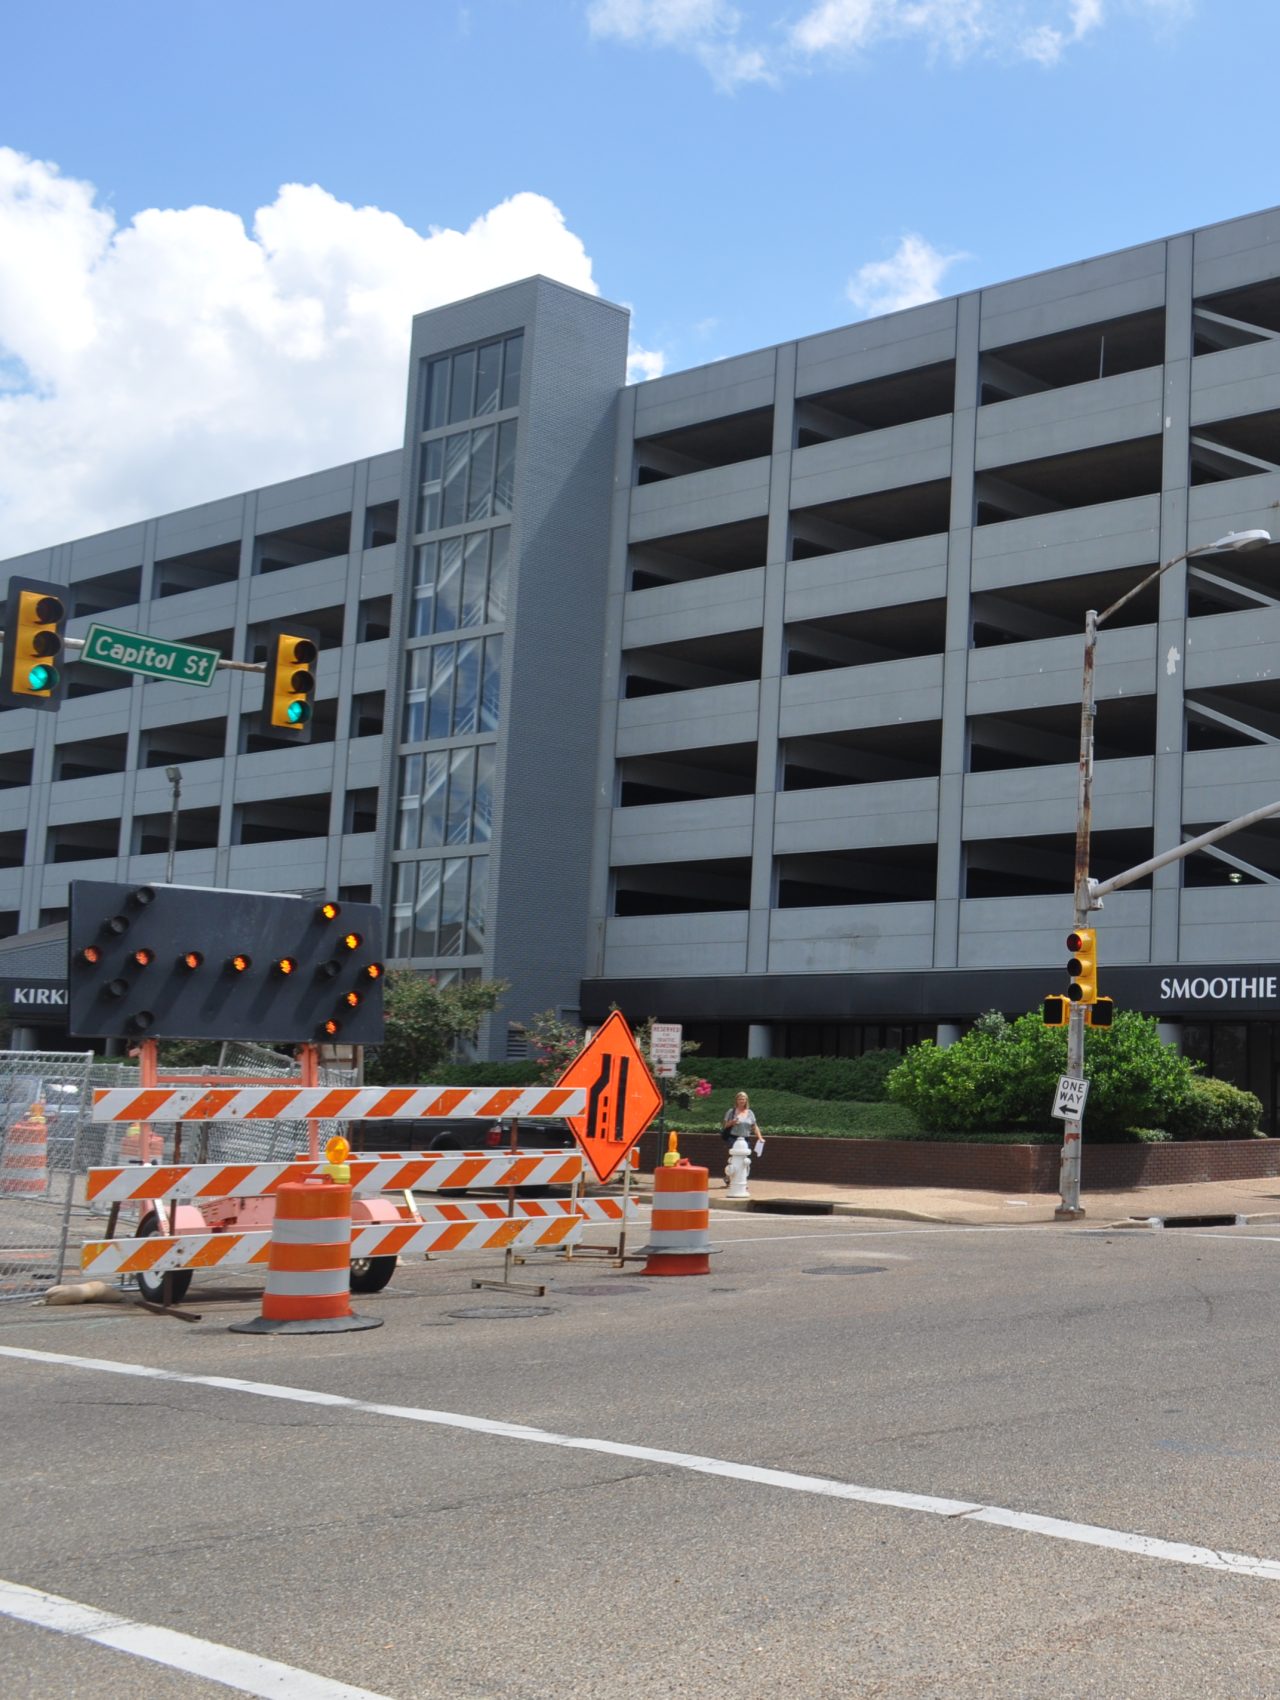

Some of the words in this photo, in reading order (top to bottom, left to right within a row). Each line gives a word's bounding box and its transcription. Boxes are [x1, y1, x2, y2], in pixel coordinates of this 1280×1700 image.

[95, 636, 176, 670] Capitol
[184, 655, 209, 676] St
[1160, 976, 1277, 999] SMOOTHIE
[1062, 1080, 1085, 1093] ONE
[1060, 1091, 1083, 1104] WAY
